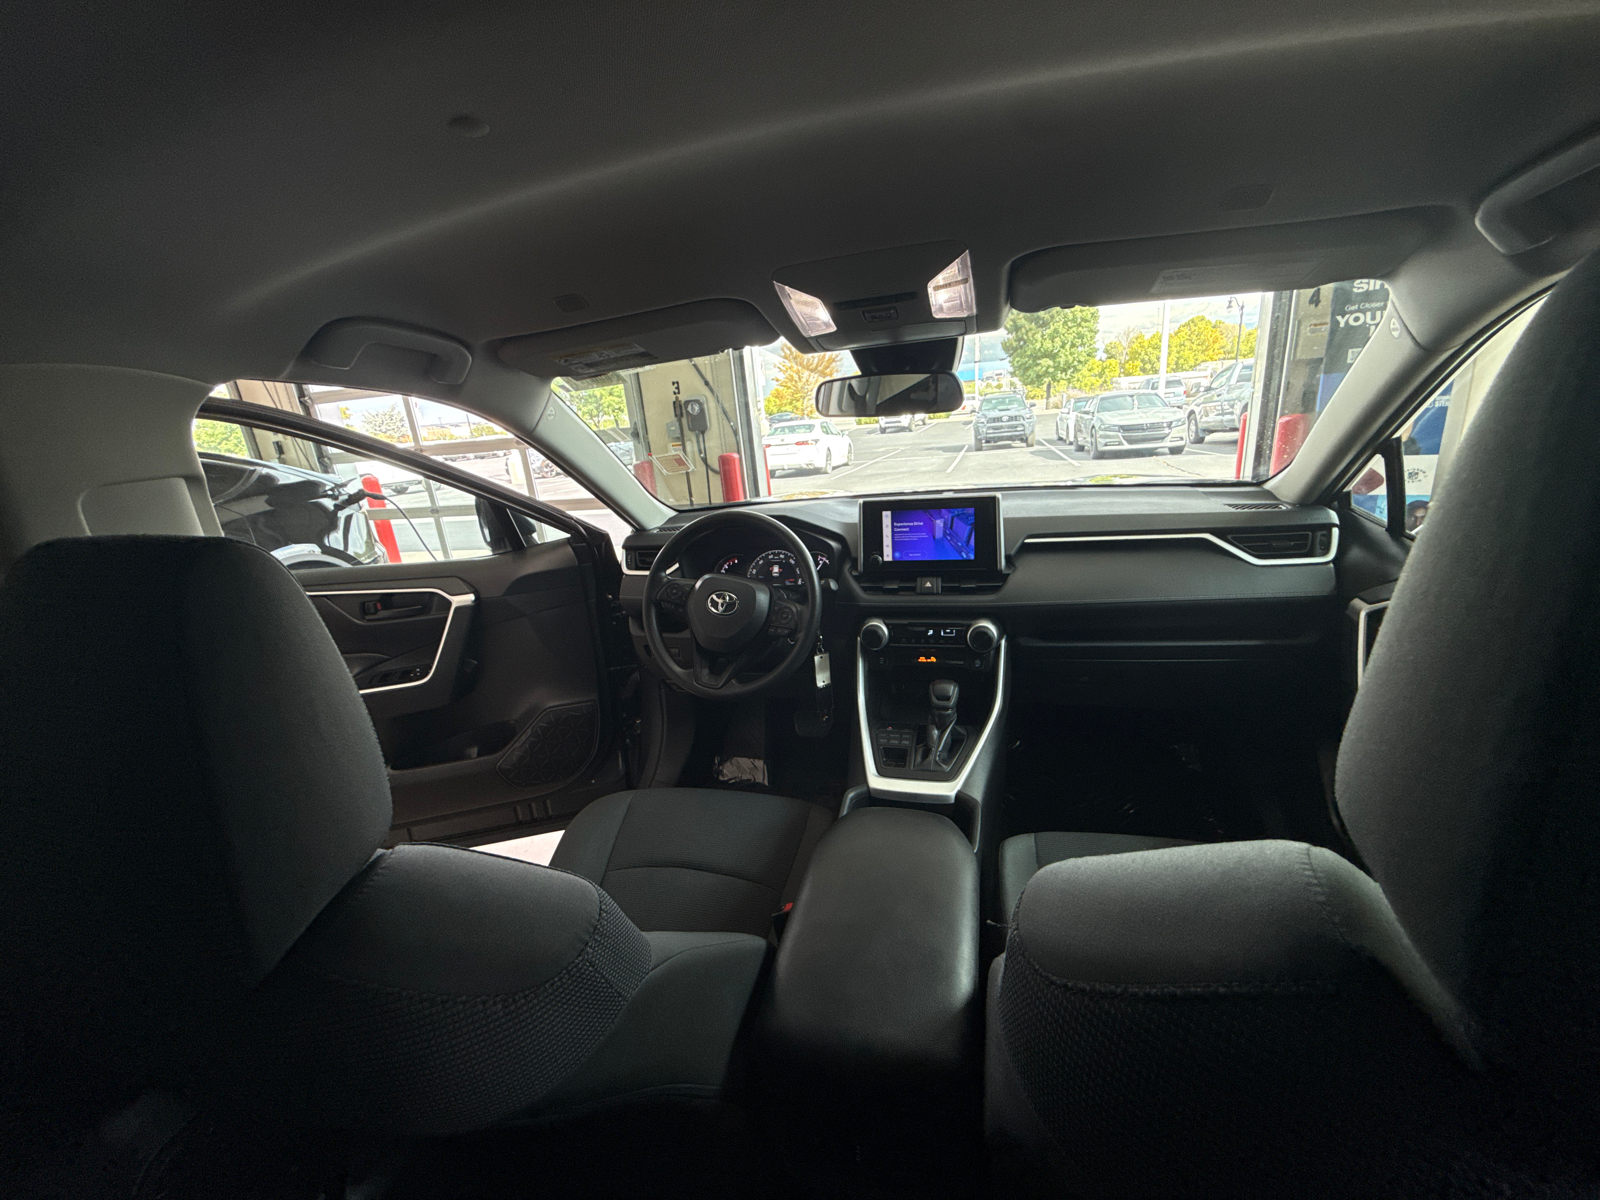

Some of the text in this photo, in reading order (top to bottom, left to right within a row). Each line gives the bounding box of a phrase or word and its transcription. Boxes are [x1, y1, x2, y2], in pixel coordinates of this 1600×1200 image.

[1308, 287, 1321, 307] 4
[1335, 310, 1386, 328] YOU
[671, 380, 681, 396] 3
